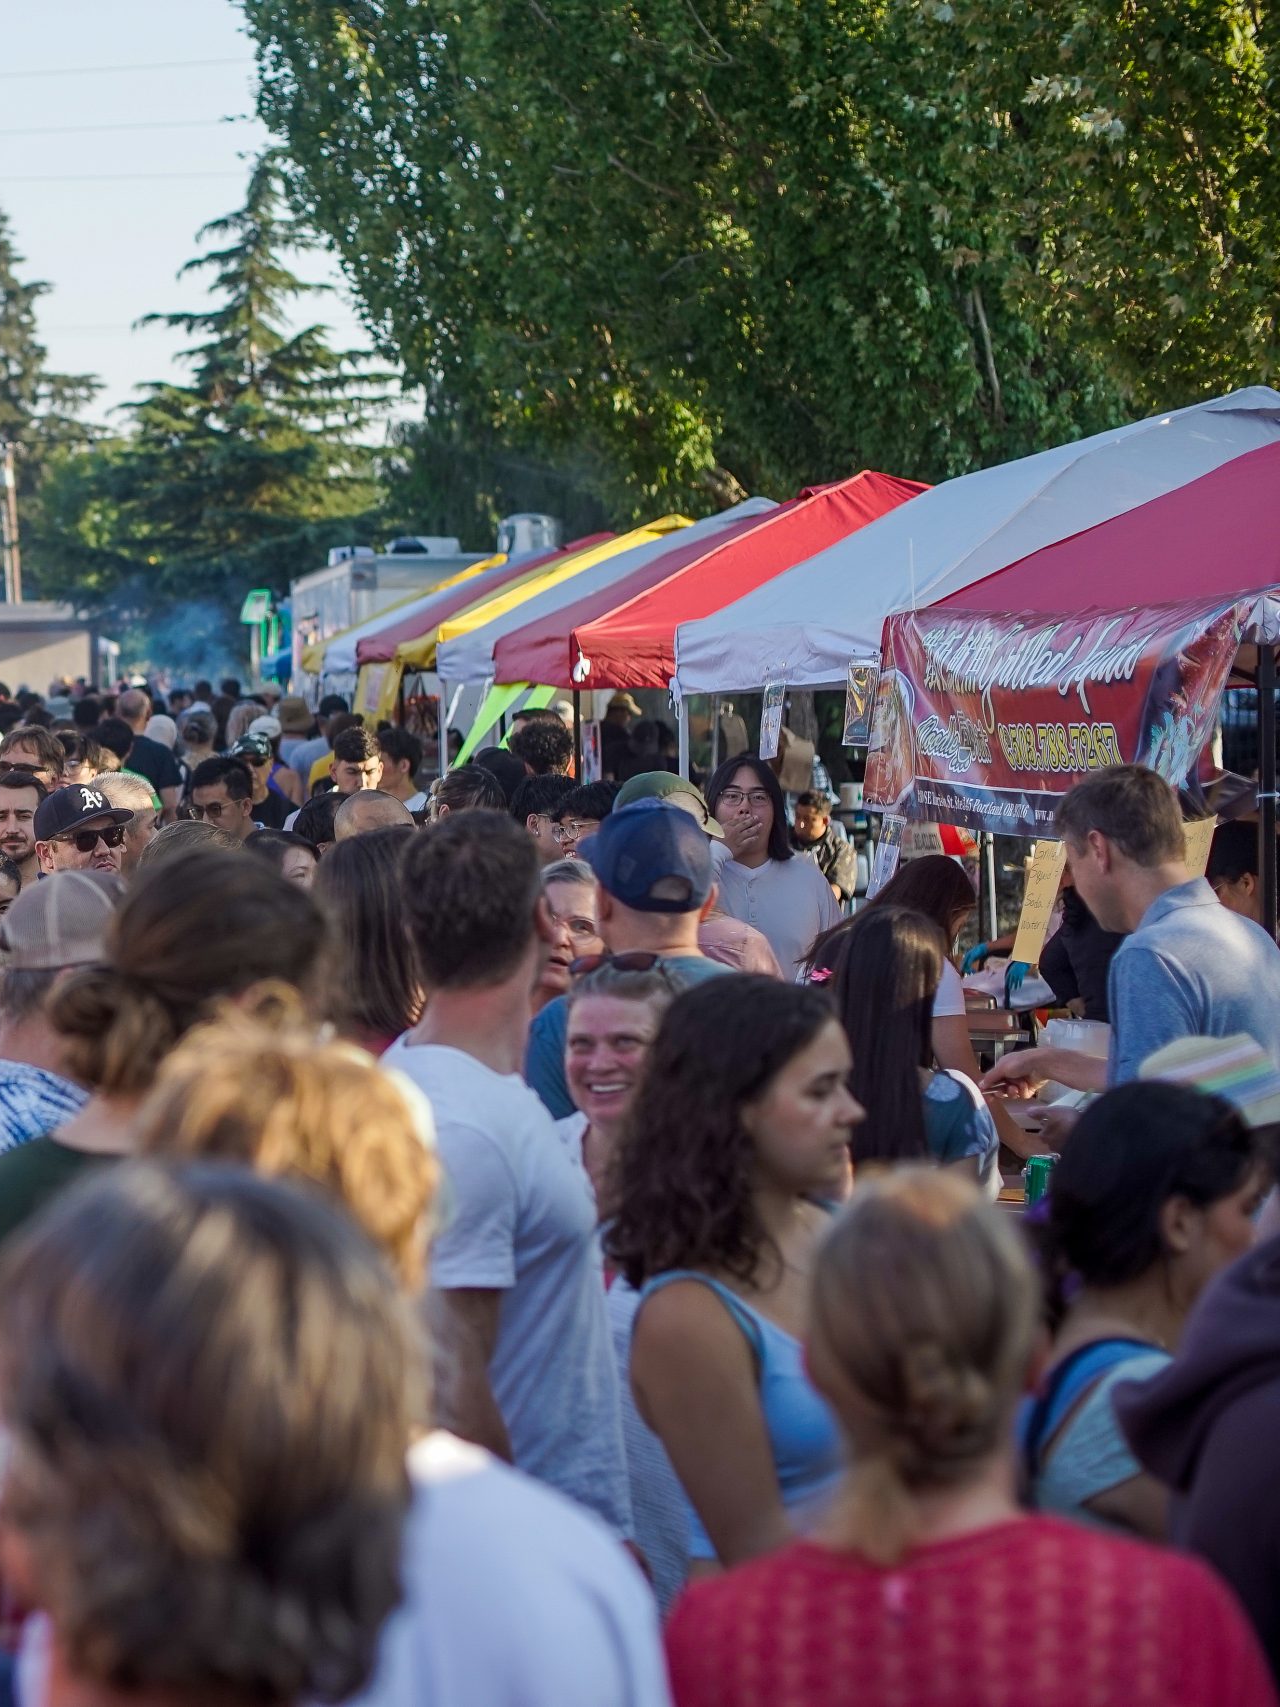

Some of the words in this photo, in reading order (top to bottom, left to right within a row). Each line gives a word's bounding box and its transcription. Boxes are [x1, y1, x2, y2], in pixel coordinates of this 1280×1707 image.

[979, 622, 1083, 735] Grilled
[1058, 617, 1159, 714] Squid
[972, 798, 1003, 816] Portland
[1033, 841, 1058, 861] Grille
